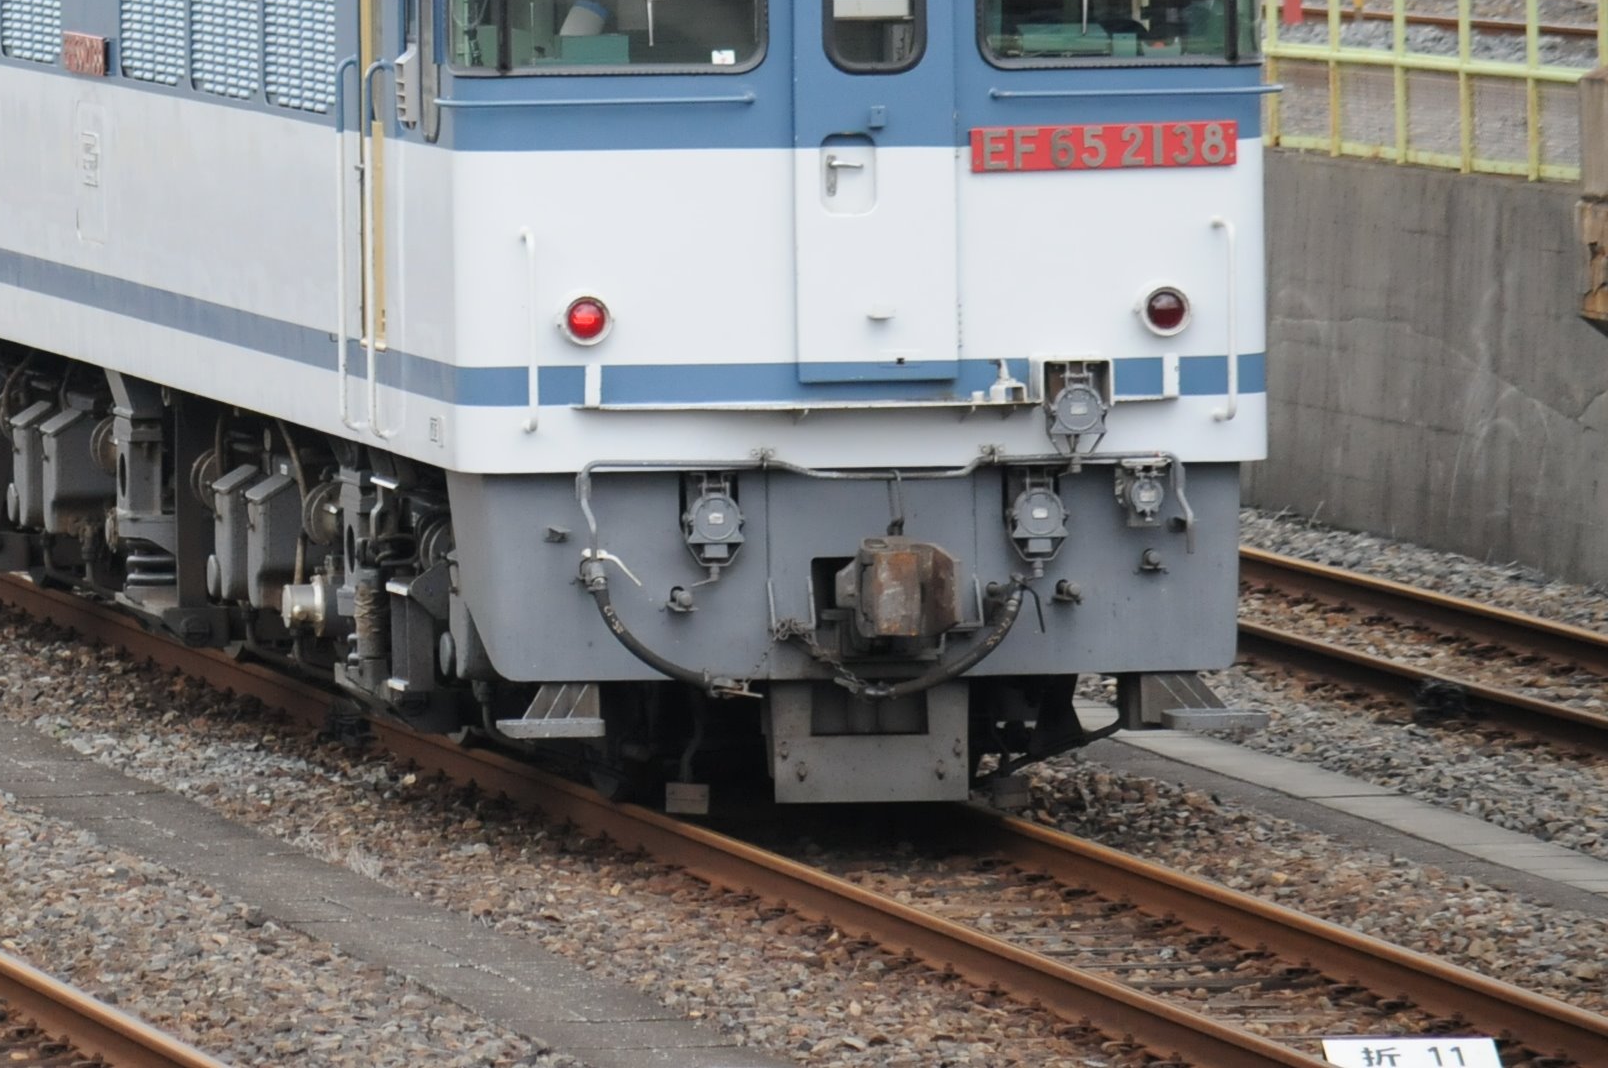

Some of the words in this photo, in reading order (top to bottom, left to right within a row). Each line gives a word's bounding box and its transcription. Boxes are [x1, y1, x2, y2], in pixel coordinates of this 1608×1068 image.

[982, 127, 1040, 170] EF
[1050, 125, 1107, 168] 65
[1120, 122, 1228, 166] 2138
